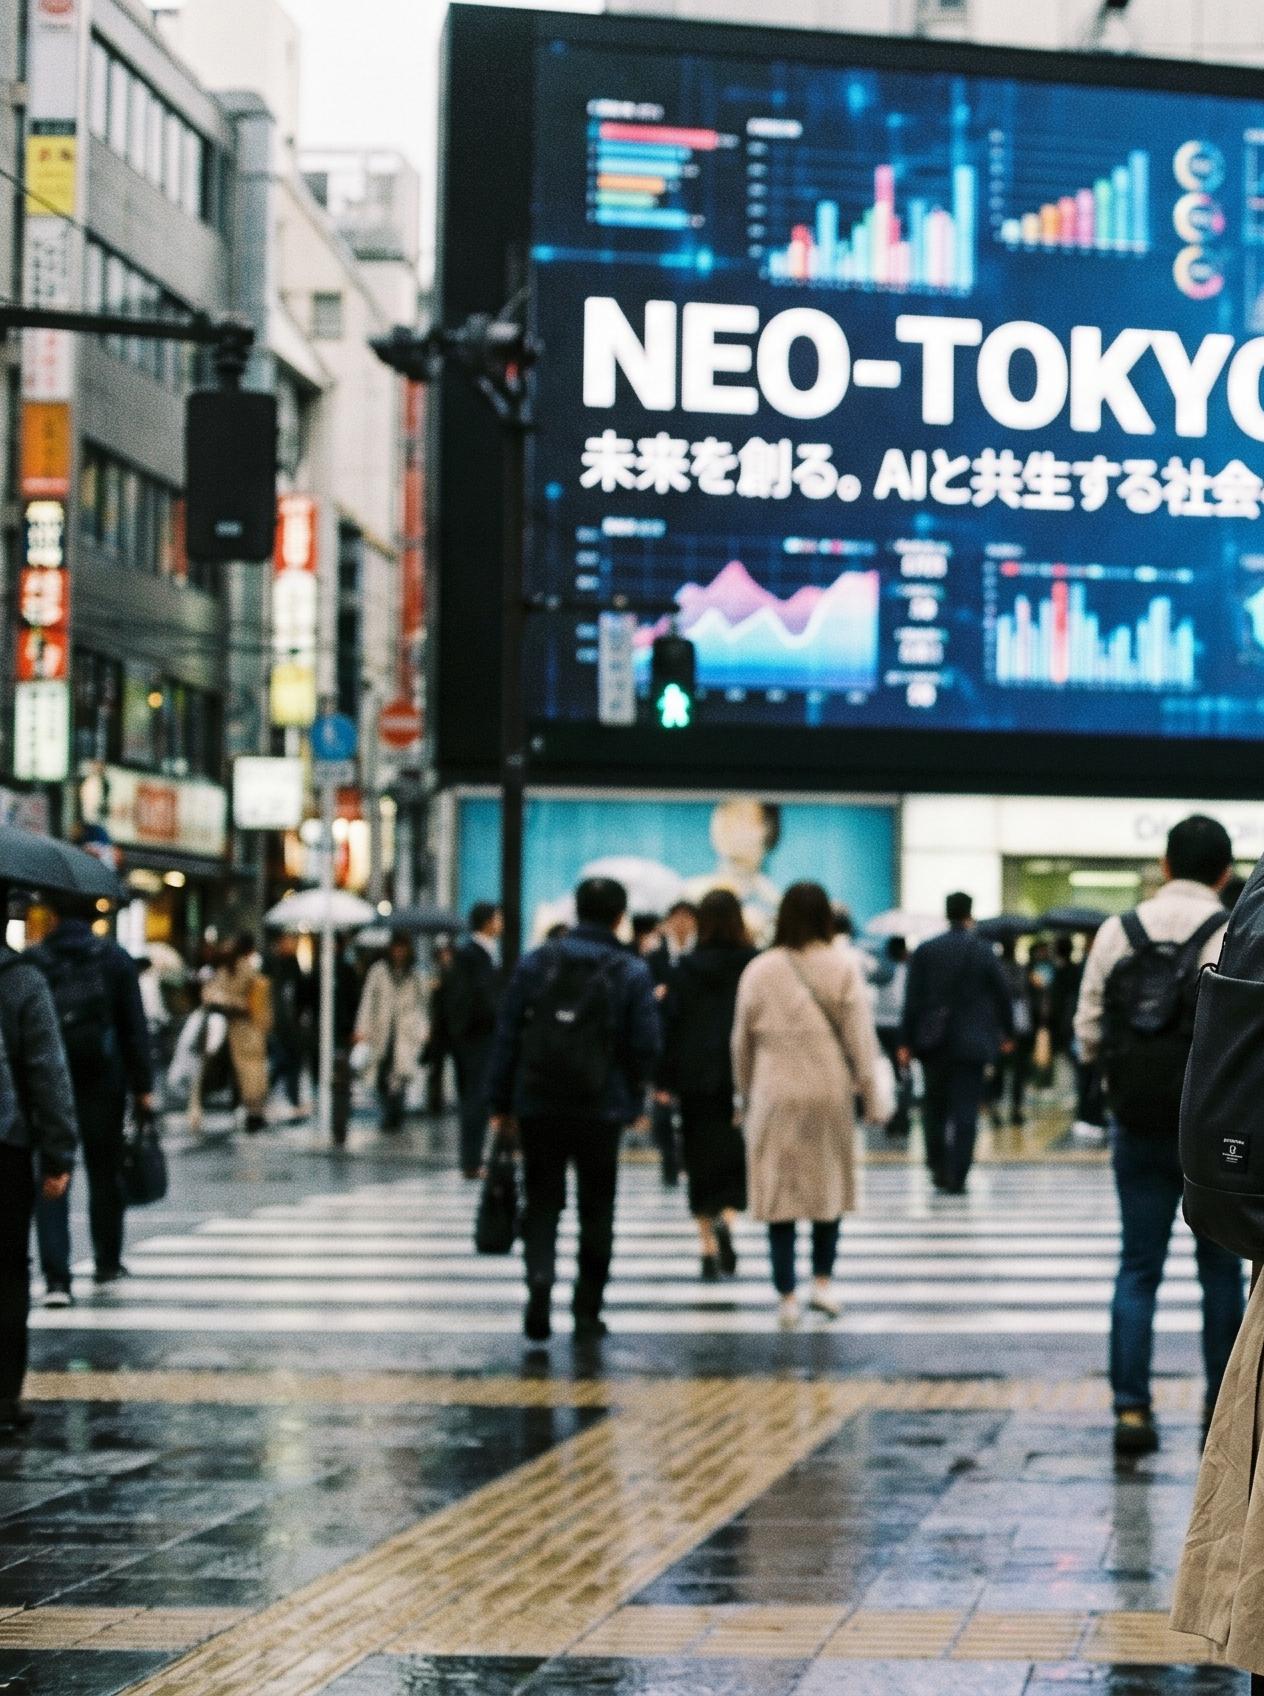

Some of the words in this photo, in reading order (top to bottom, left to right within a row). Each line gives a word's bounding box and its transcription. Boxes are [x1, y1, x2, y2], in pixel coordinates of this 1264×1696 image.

[579, 428, 862, 502] 未来を創る。
